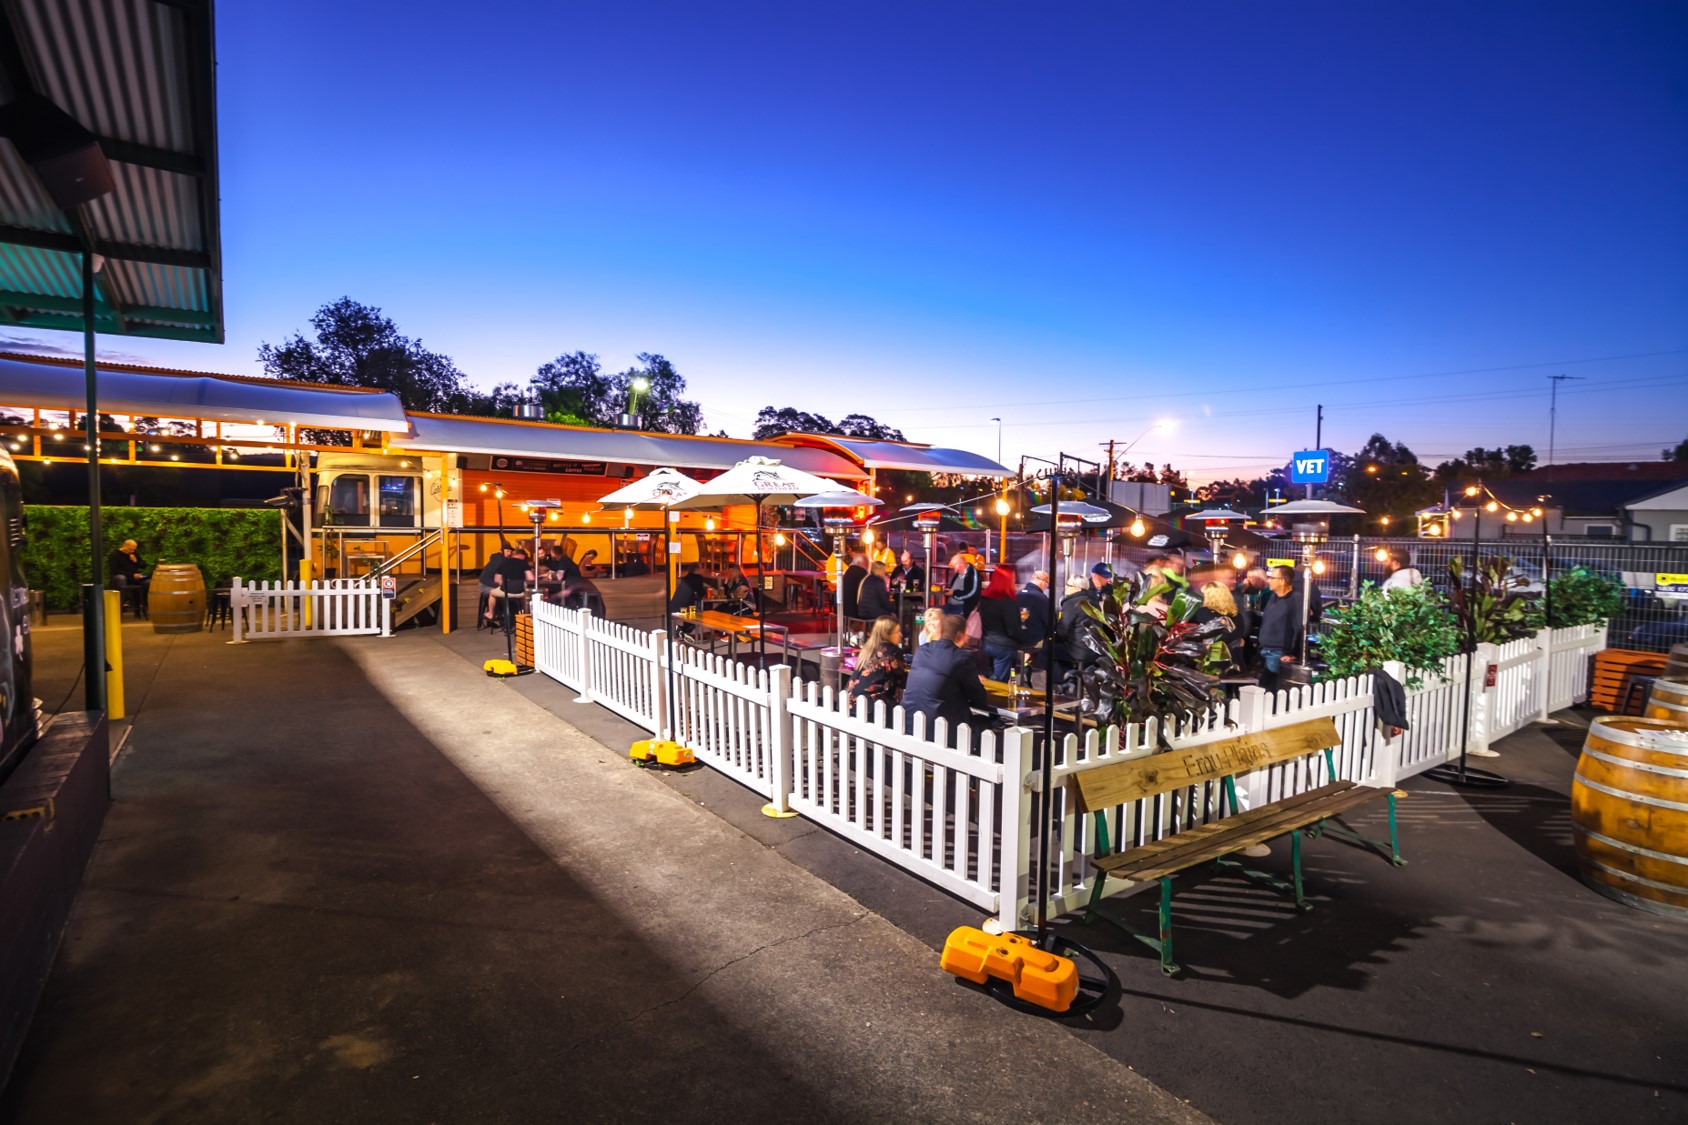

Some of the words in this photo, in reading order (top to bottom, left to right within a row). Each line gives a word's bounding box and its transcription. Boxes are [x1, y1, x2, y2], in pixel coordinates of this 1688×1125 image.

[1296, 459, 1325, 475] VET
[1182, 753, 1223, 777] Emu
[1223, 742, 1272, 769] Plains
